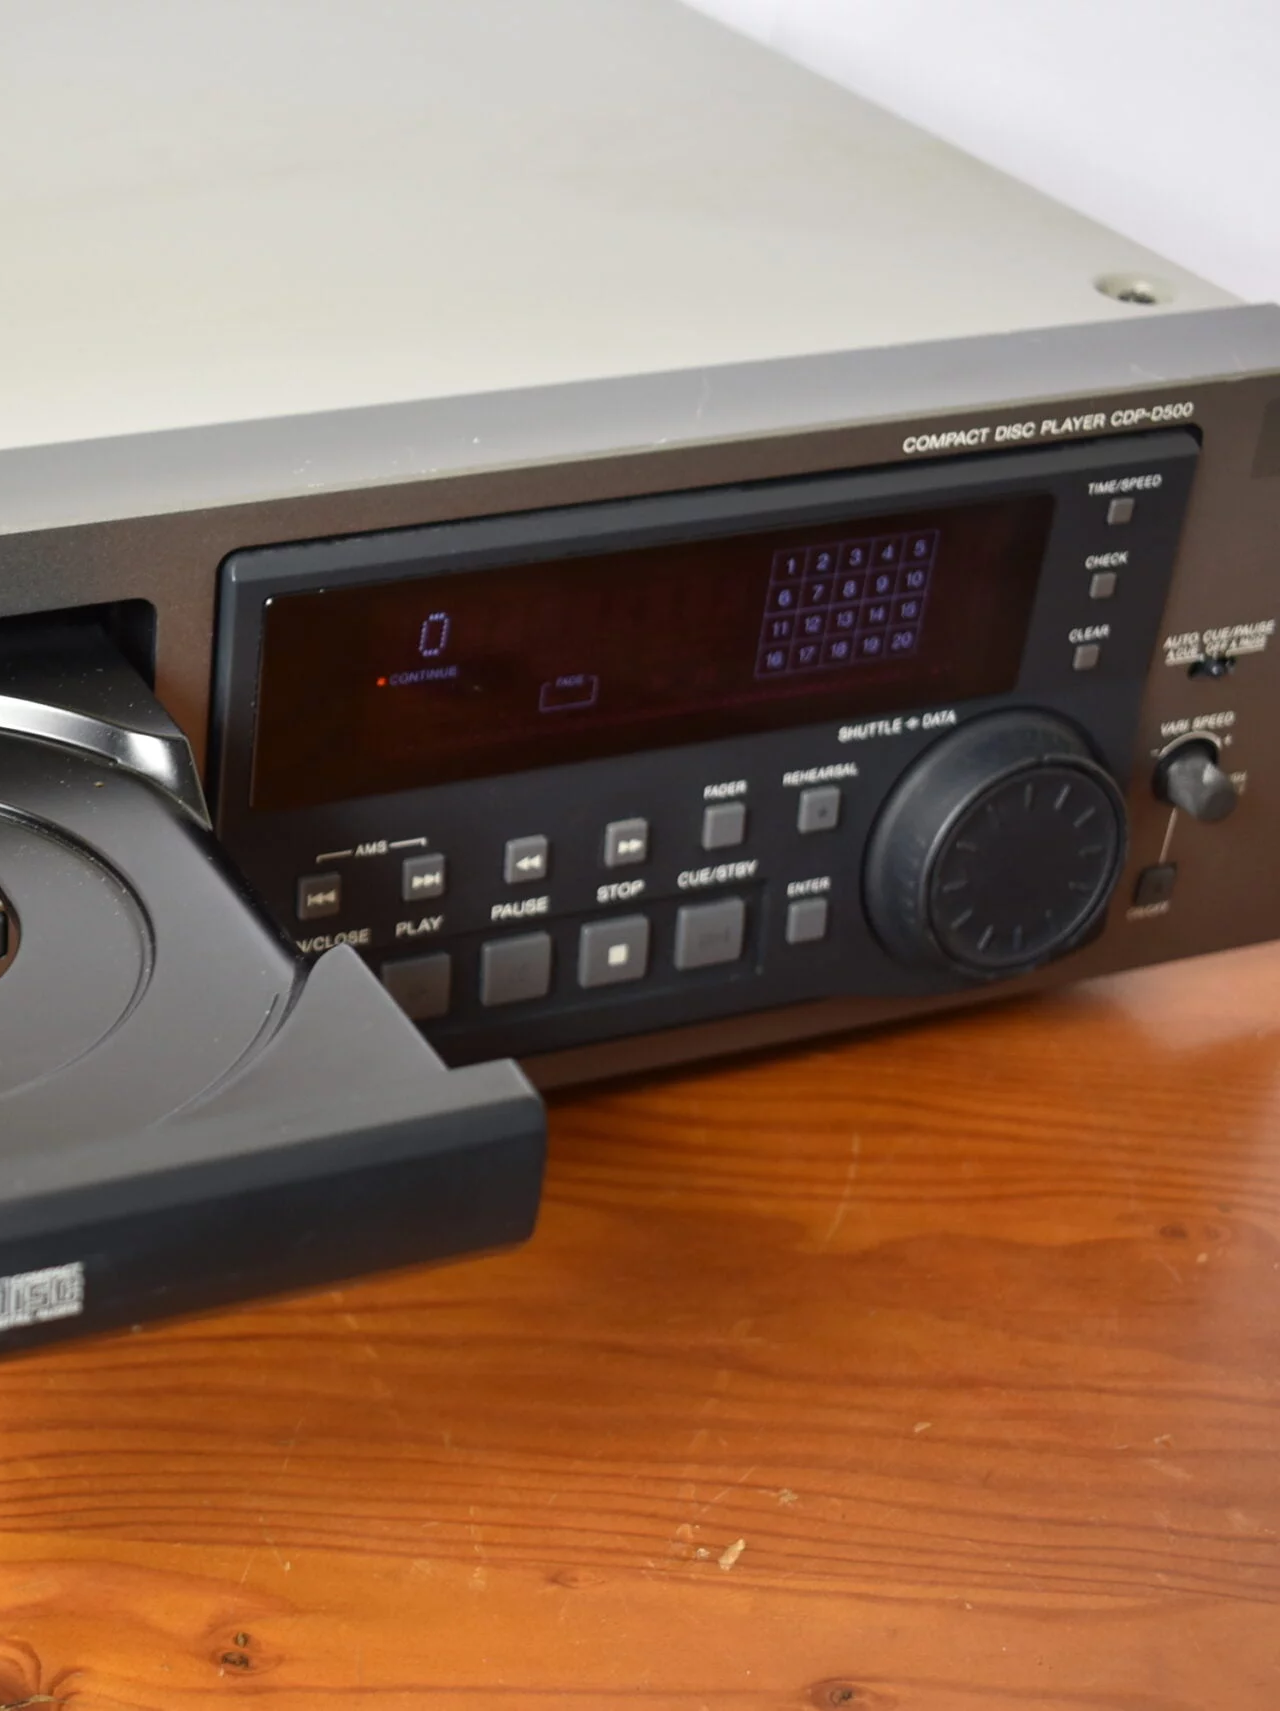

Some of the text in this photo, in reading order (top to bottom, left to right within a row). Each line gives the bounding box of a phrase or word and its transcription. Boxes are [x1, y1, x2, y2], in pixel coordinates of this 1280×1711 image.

[902, 402, 1194, 453] COMPACT DISC PLAYER CDP-D500
[1087, 474, 1163, 495] TIME/SPEED
[1085, 551, 1128, 570] CHECK
[419, 612, 450, 657] 0
[1068, 624, 1110, 643] CLEAR
[1163, 619, 1275, 651] AUTO CUE/PAUSE
[389, 665, 458, 687] CONTINUE
[838, 710, 957, 743] SHUTTLE DATA
[1160, 710, 1236, 737] VARI SPEED
[782, 762, 859, 787] REHEARSAL
[703, 780, 747, 799] FADER
[354, 839, 389, 857] AMS
[677, 859, 759, 889] CUE/STBY
[787, 876, 831, 896] ENTER
[596, 879, 645, 902] STOP
[490, 894, 550, 922] PAUSE
[395, 914, 444, 938] PLAY
